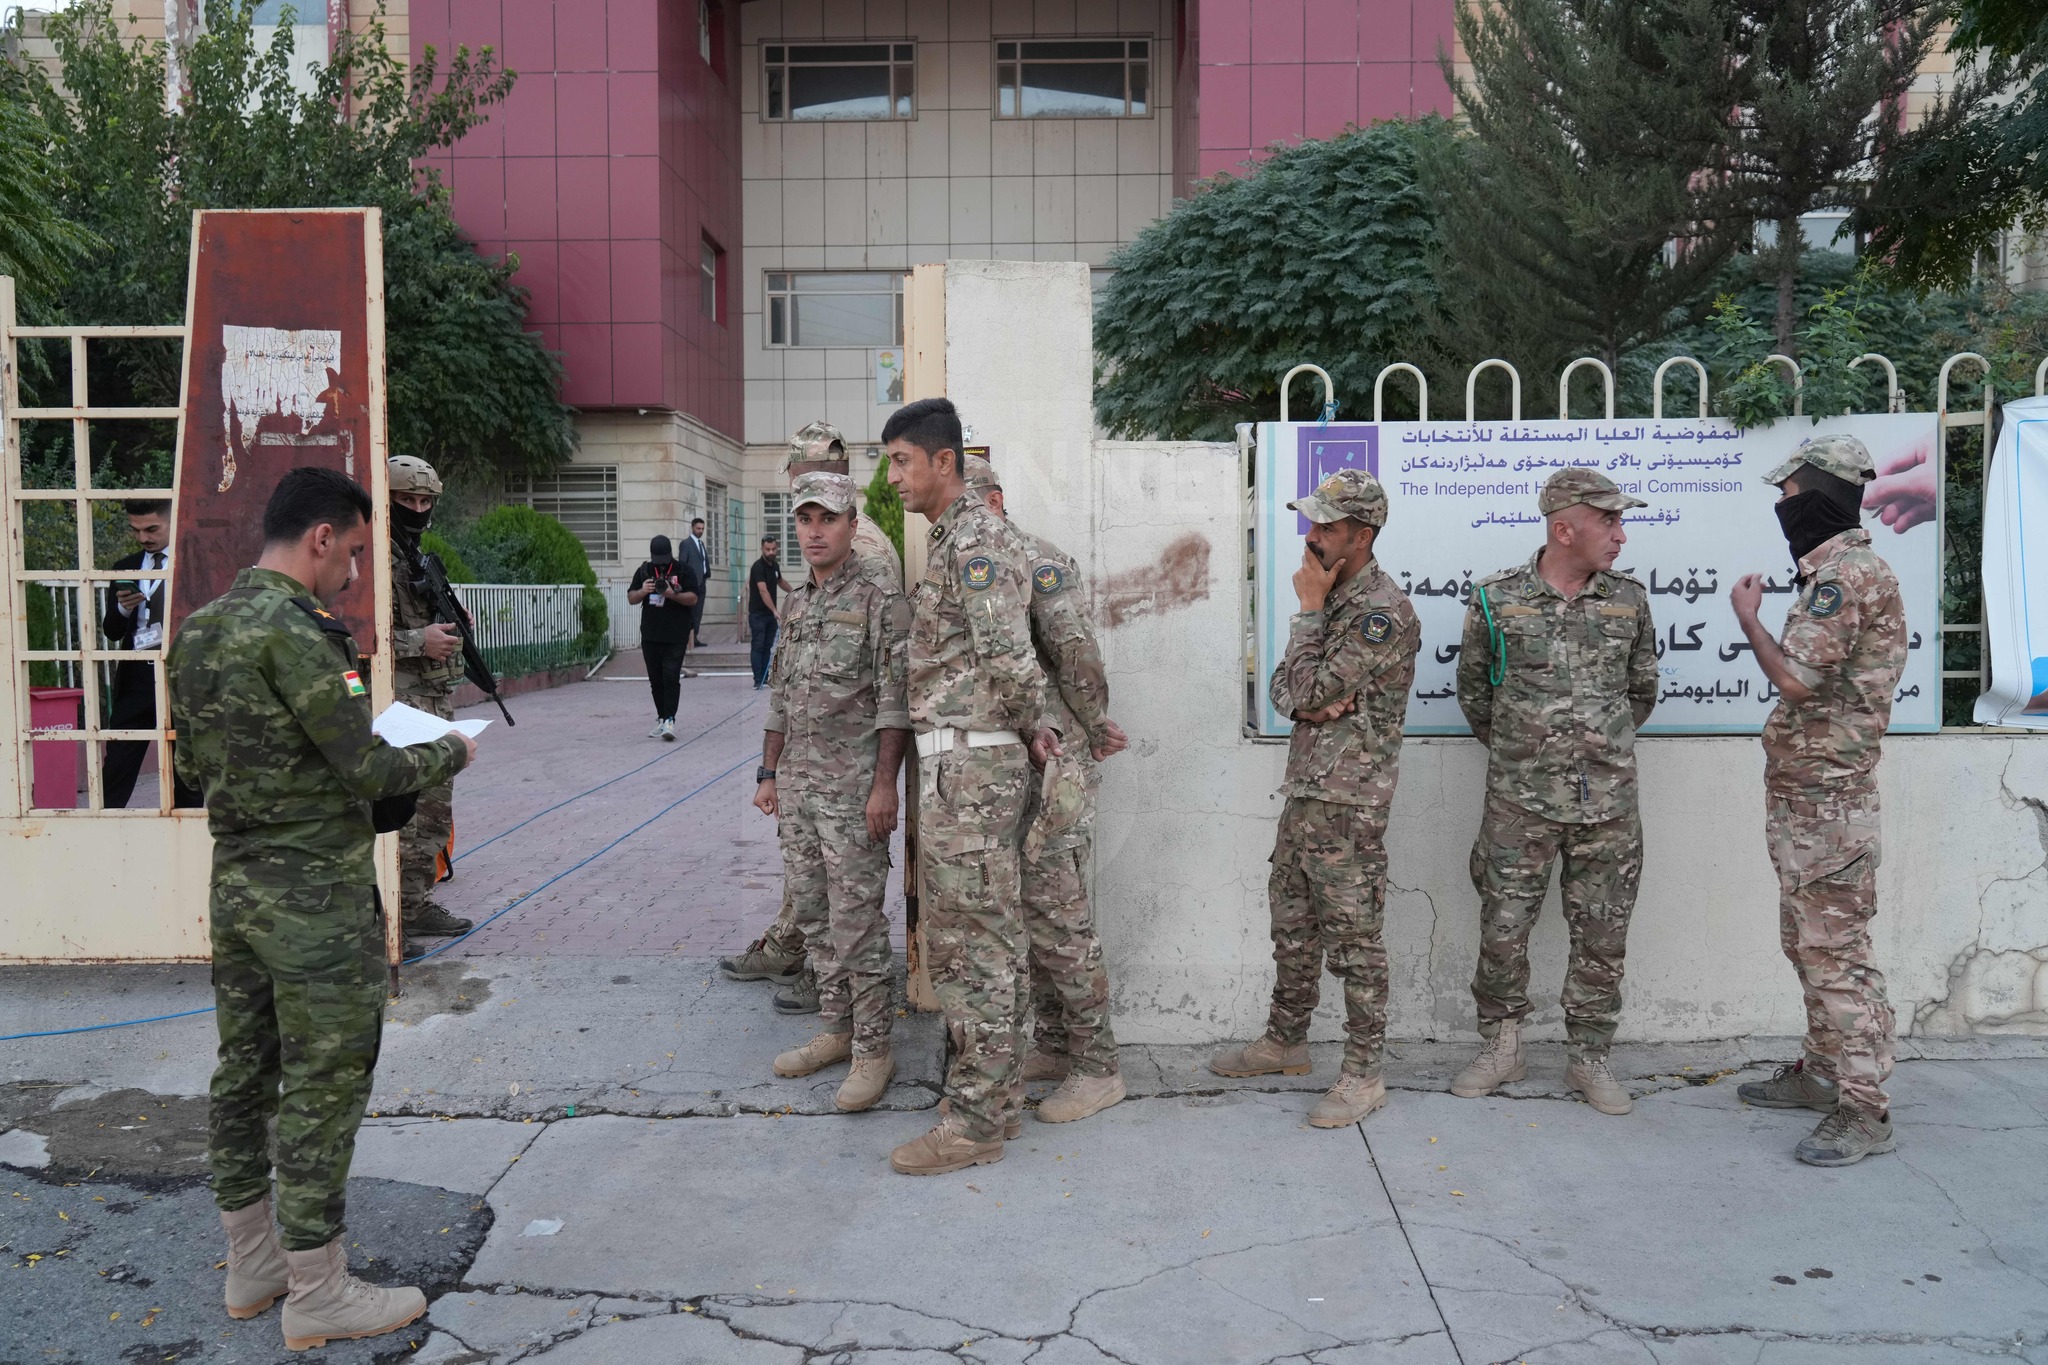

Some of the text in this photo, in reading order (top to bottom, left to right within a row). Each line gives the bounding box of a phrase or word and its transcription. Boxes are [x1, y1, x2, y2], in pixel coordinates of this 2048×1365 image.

[1401, 423, 1745, 447] المفوضية العليا المستقلة للأنتخابات
[1399, 482, 1429, 496] The
[1435, 481, 1530, 498] Independent
[1647, 479, 1743, 493] Commission
